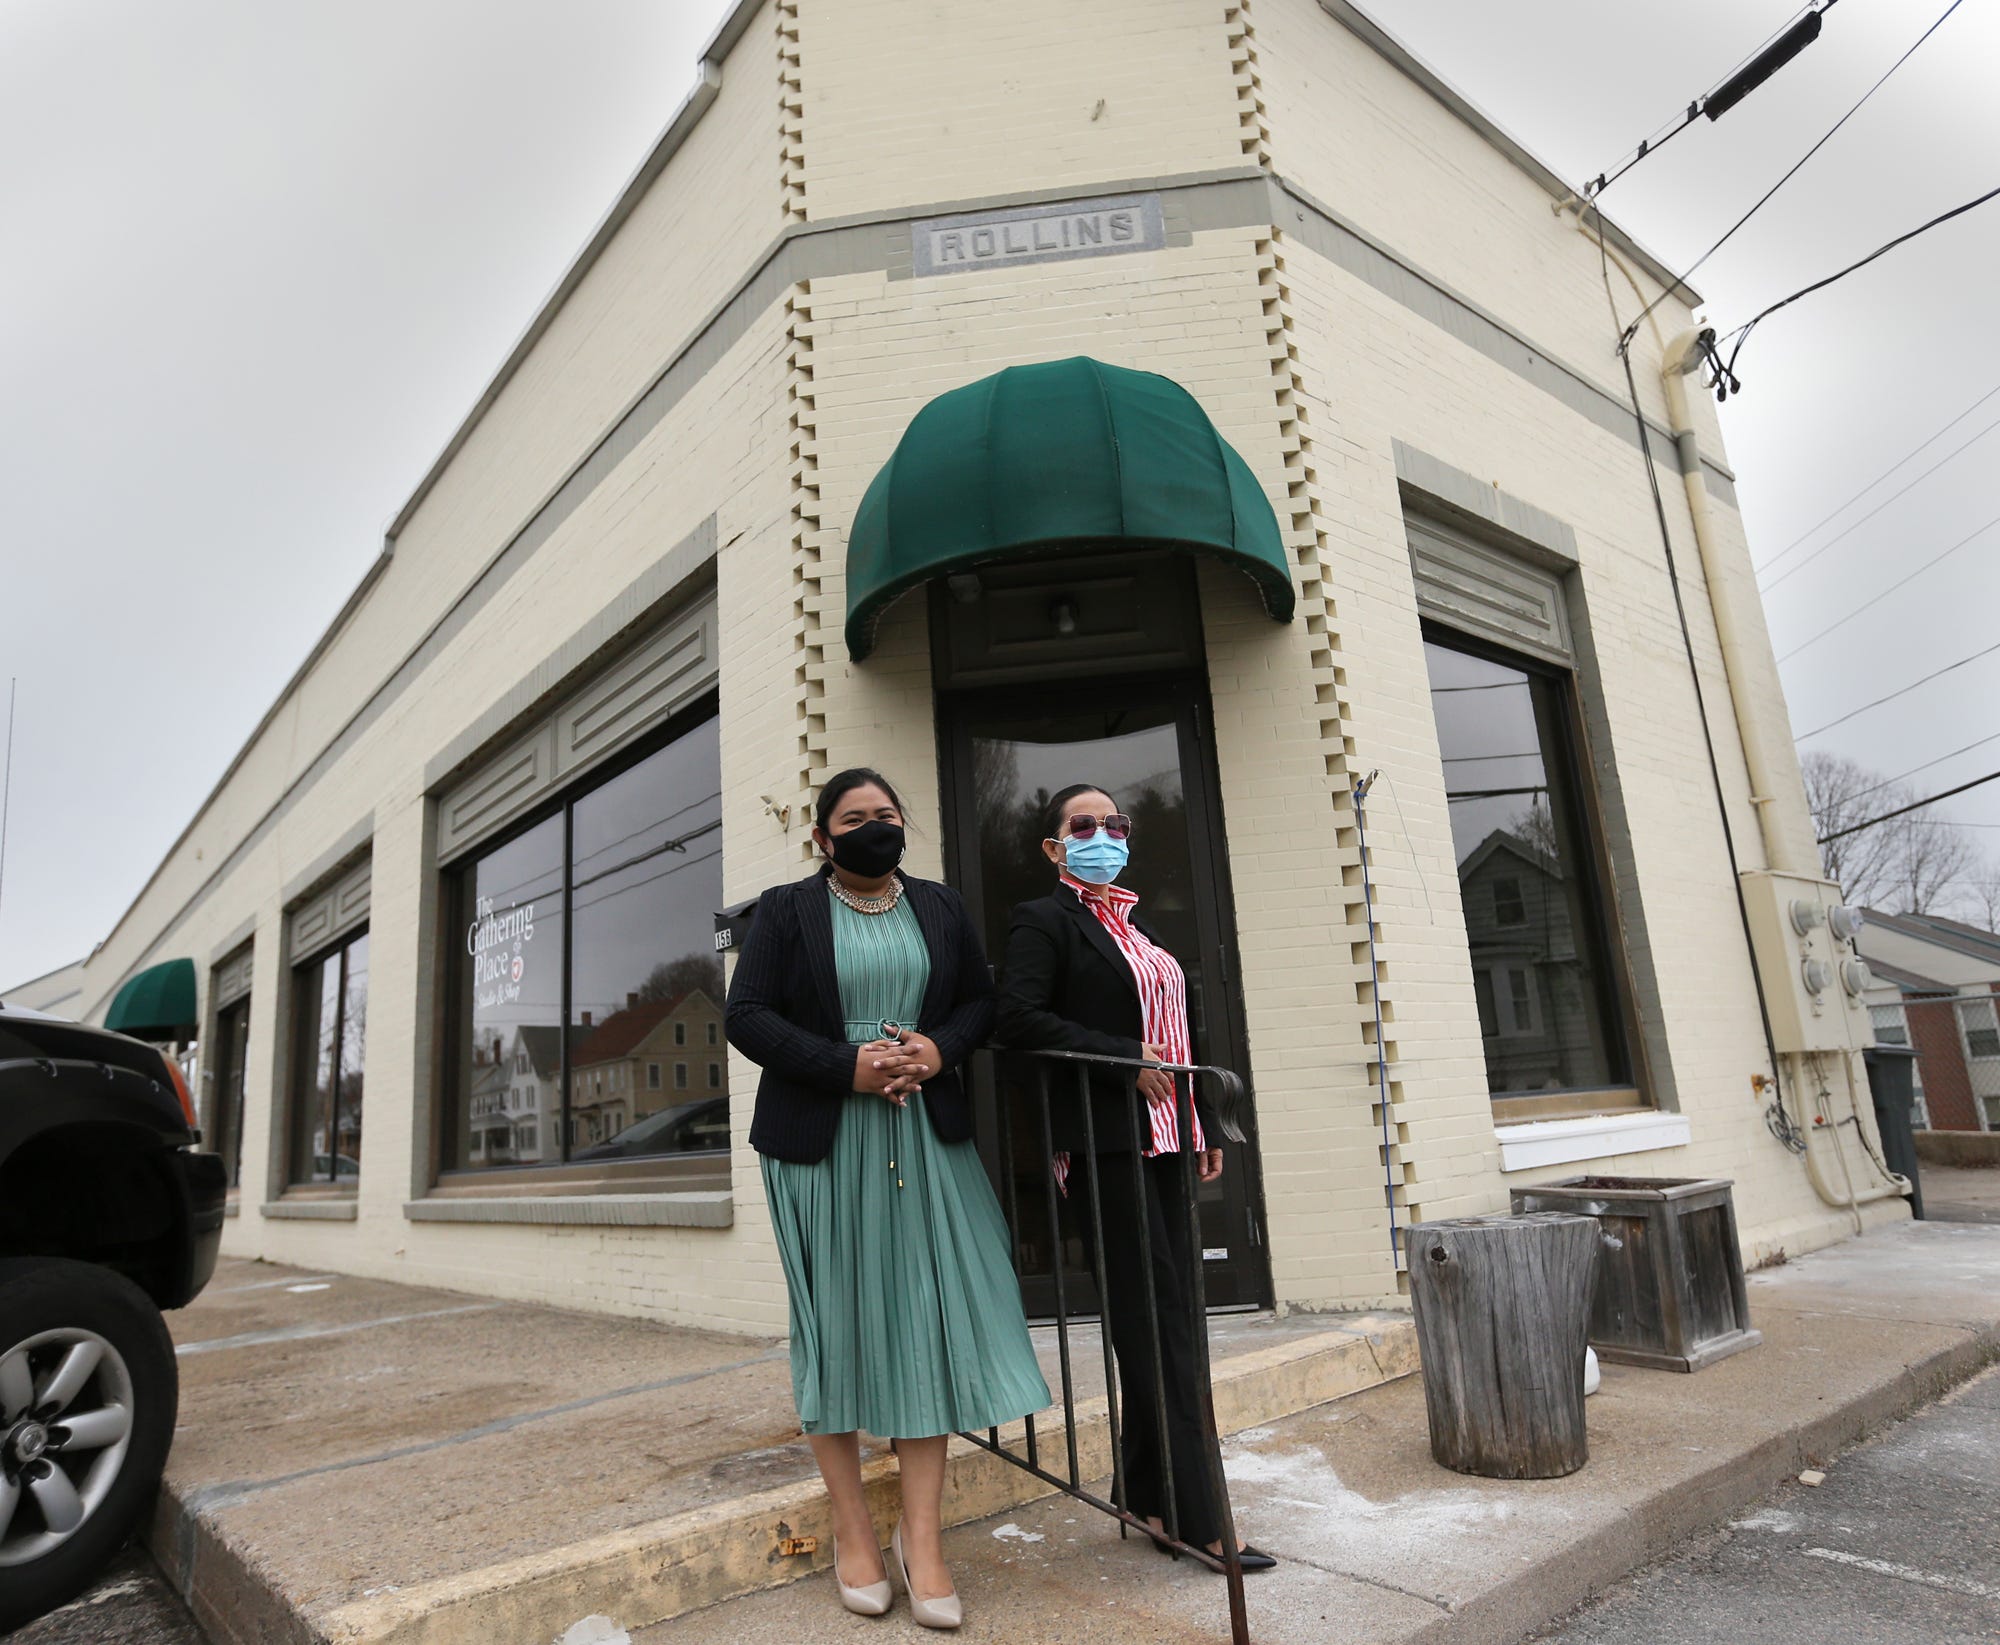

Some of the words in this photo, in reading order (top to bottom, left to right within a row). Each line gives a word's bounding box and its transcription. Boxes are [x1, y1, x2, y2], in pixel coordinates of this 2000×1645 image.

[941, 212, 1135, 262] ROLLINS
[476, 896, 493, 920] The
[467, 902, 534, 956] Gathering
[716, 930, 731, 947] 156
[474, 951, 509, 987] Place
